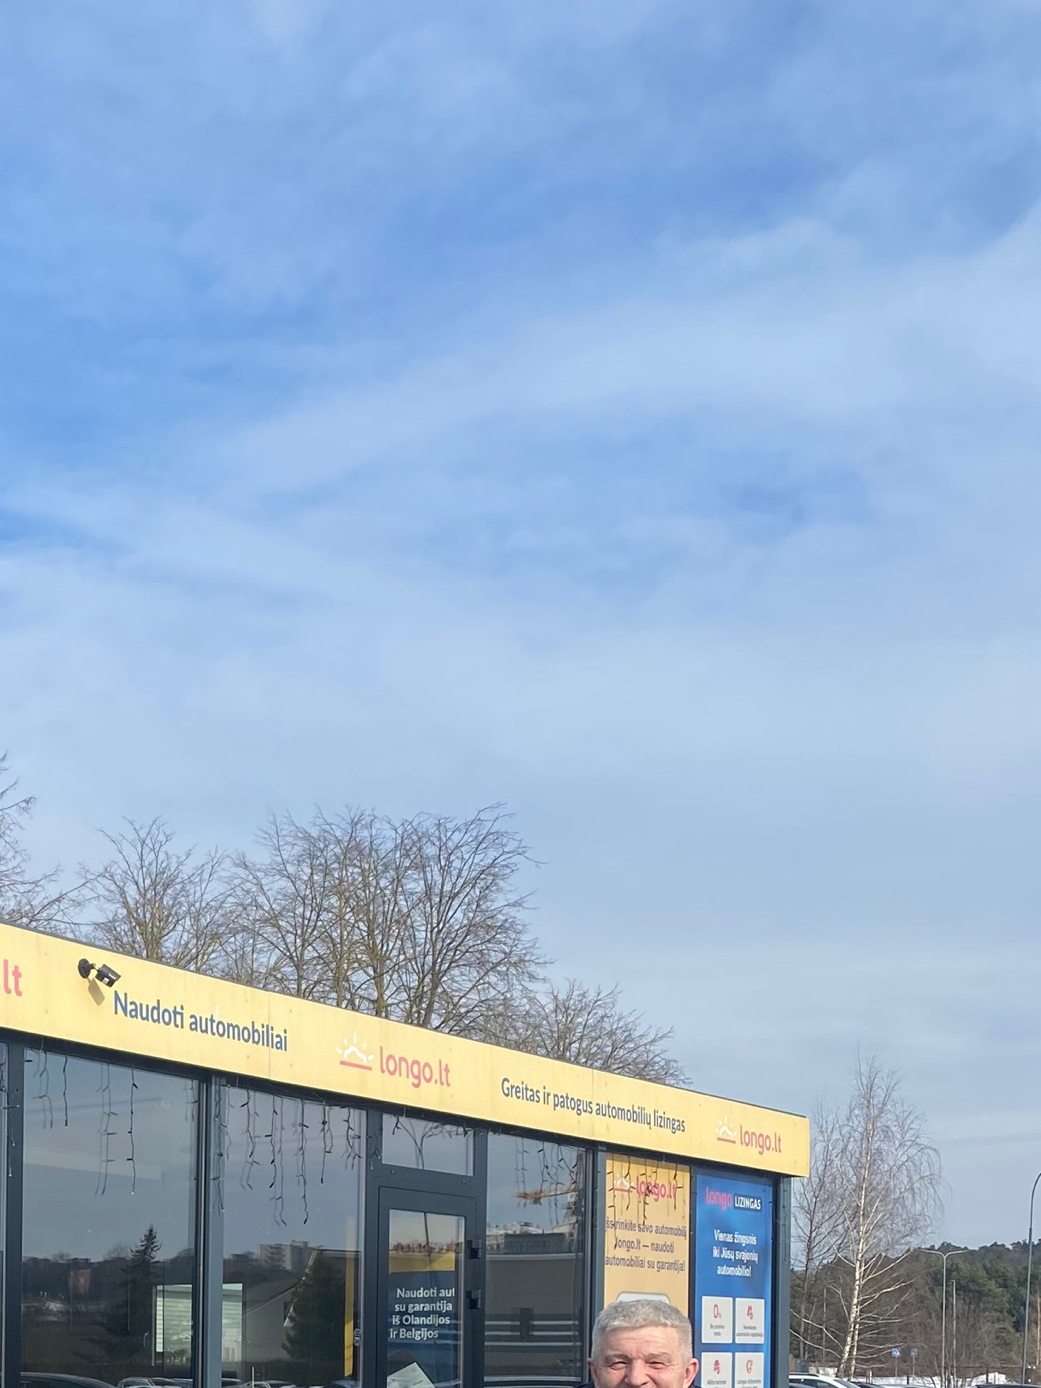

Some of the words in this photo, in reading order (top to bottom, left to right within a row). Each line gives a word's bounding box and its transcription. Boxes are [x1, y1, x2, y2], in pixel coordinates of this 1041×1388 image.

[114, 990, 184, 1029] Naudoti
[189, 1013, 288, 1052] automobiliai
[379, 1046, 451, 1089] longo.lt
[501, 1077, 540, 1103] Greitas
[543, 1086, 551, 1105] ir
[553, 1093, 593, 1116] patogus
[595, 1102, 652, 1129] automobilių
[653, 1110, 686, 1133] lizingas
[740, 1124, 782, 1155] longo.lt
[735, 1195, 761, 1210] LIZINGAS
[713, 1229, 733, 1242] Vienas
[396, 1287, 437, 1299] Naudoti
[439, 1287, 455, 1298] aut
[394, 1304, 406, 1312] su
[408, 1301, 453, 1313] garantija
[392, 1315, 400, 1325] iš
[402, 1314, 451, 1327] Olandijos
[390, 1328, 398, 1339] ir
[399, 1328, 439, 1341] Belgijos
